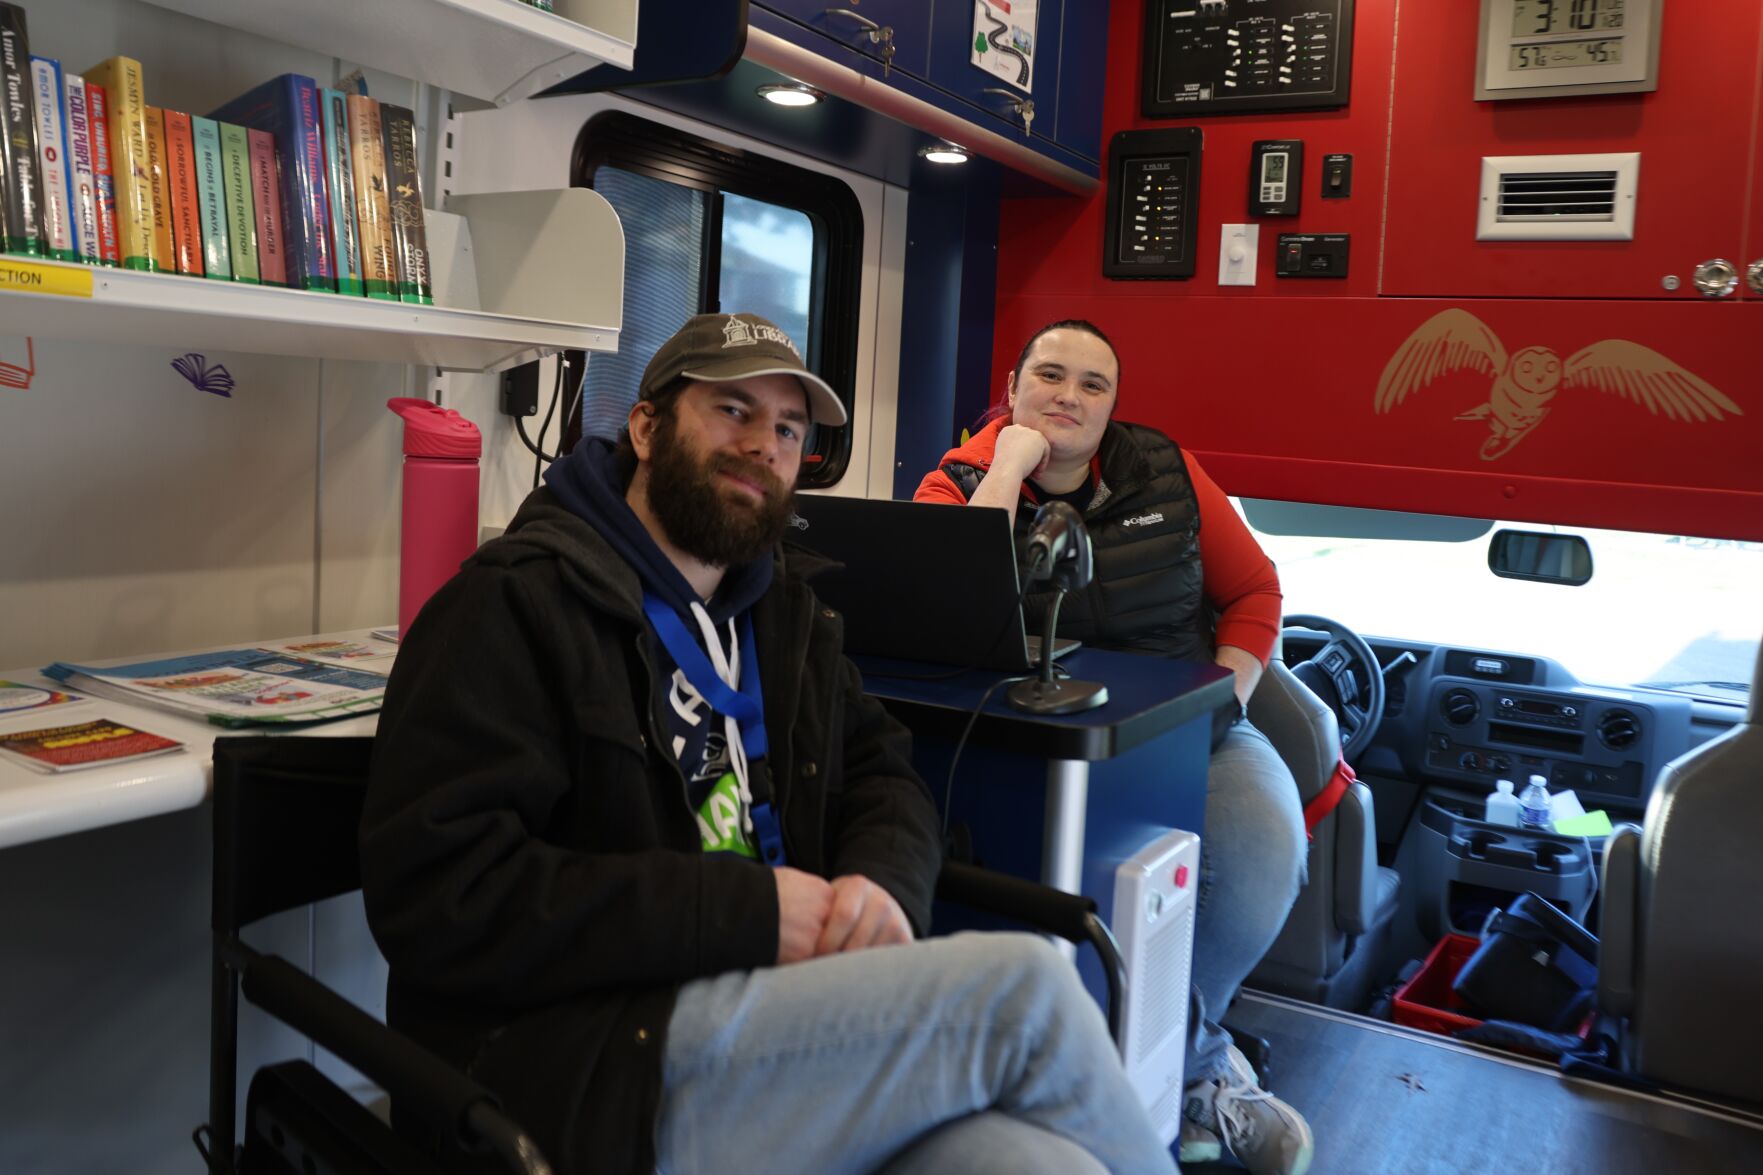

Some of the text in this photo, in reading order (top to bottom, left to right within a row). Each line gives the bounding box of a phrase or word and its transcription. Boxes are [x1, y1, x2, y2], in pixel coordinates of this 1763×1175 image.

[2, 28, 24, 122] Amor Towles
[42, 103, 53, 140] TOWLES
[69, 86, 90, 175] THE COLOR PURPLE
[127, 66, 142, 158] JESMYN WARD
[304, 132, 319, 183] Williams
[359, 113, 371, 160] YARROS
[389, 122, 402, 167] YARROS
[402, 120, 414, 174] REBECCA
[49, 169, 58, 185] THE
[175, 143, 188, 203] SORROWFUL
[205, 152, 216, 183] BEGINS
[232, 155, 243, 203] DECEPTIVE
[138, 184, 147, 203] Let
[141, 208, 150, 221] Us
[154, 196, 163, 228] GRAVE
[208, 193, 218, 237] BETRAYAL
[261, 160, 269, 194] MATCH
[265, 216, 275, 255] MURDER
[181, 207, 193, 264] SANCTUARY
[237, 206, 247, 255] DEVOTION
[374, 245, 385, 279] WING
[406, 243, 418, 285] STORM
[414, 249, 426, 285] ONYX
